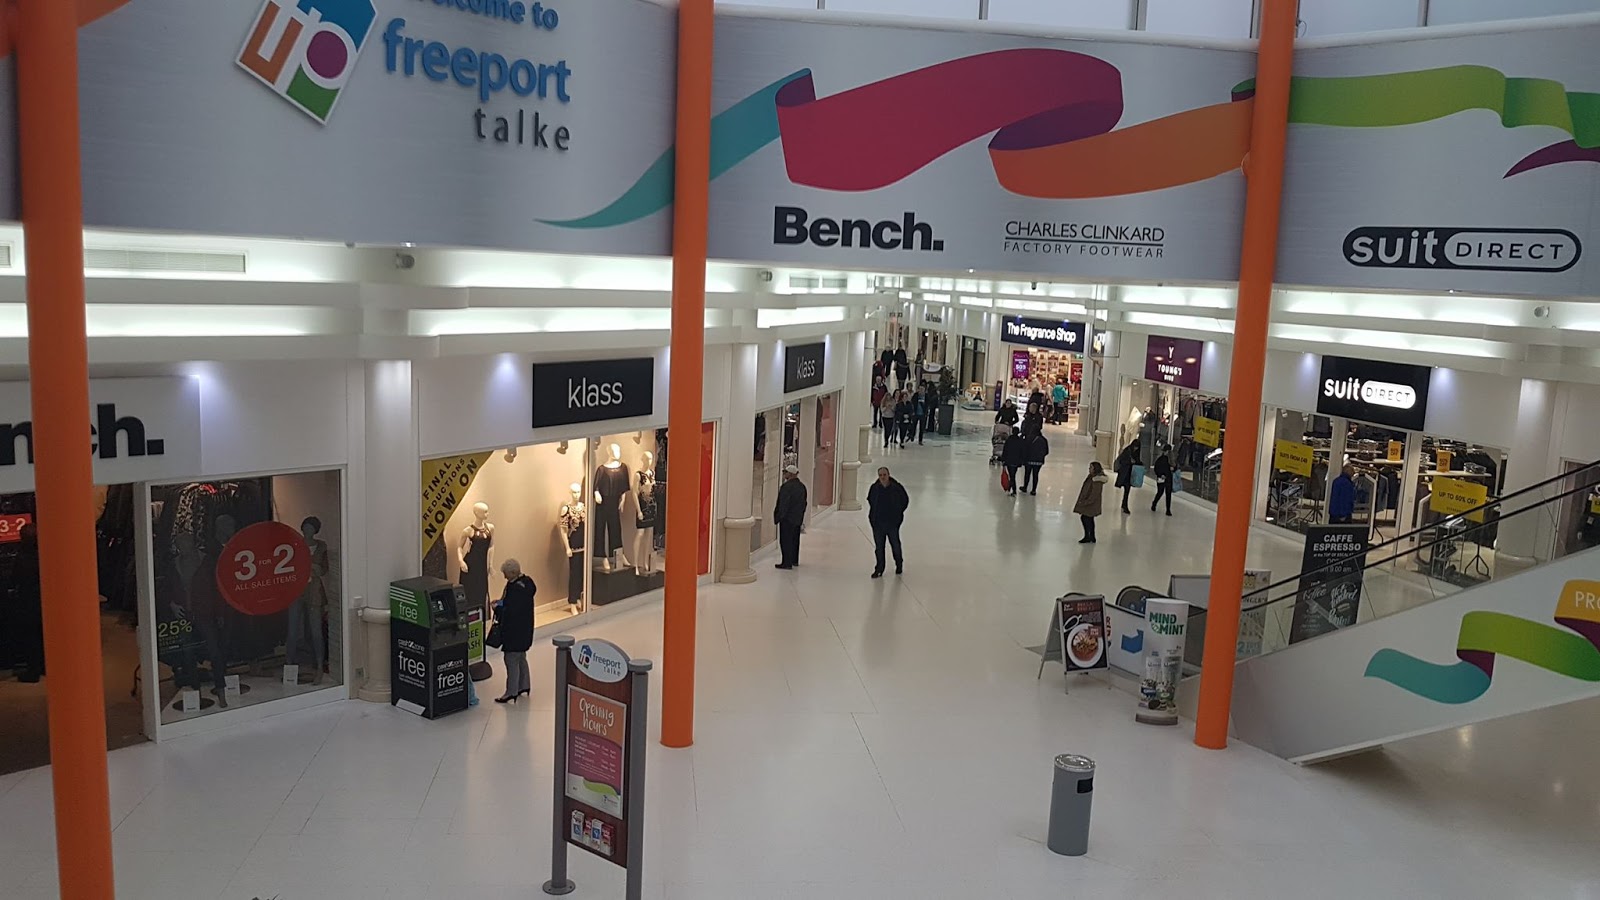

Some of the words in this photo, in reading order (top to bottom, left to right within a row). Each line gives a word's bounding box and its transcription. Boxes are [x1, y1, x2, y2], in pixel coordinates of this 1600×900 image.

[532, 2, 558, 31] to
[383, 17, 571, 102] freeport
[474, 108, 570, 151] talke
[773, 206, 944, 252] Bench.
[1005, 221, 1077, 238] CHARLES
[1081, 225, 1165, 242] CLINKARD
[1004, 241, 1072, 254] FACTORY
[1080, 245, 1163, 258] FOOTWEAR
[1350, 230, 1438, 265] suit
[1456, 242, 1563, 259] DIRECT
[1007, 322, 1019, 336] The
[1020, 324, 1055, 340] Fragrance
[1056, 327, 1076, 345] Shop
[797, 356, 815, 379] klass
[568, 377, 623, 409] klass
[1324, 377, 1360, 401] suit
[1366, 387, 1410, 403] DIRECT
[0, 404, 164, 465] nh.
[423, 462, 451, 500] FINAL
[423, 458, 465, 520] REDUCTIONS
[424, 492, 456, 539] NOW
[459, 458, 478, 487] ON
[1313, 543, 1361, 551] ESPRESSO
[1324, 534, 1353, 543] CAFFE
[234, 550, 257, 580] 3
[273, 544, 295, 575] 2
[235, 583, 249, 591] ALL
[251, 579, 271, 589] SALE
[273, 575, 297, 585] ITEMS
[399, 601, 418, 619] free
[1149, 612, 1177, 624] MIND
[158, 619, 193, 638] 25%
[1160, 624, 1185, 635] MINT
[398, 651, 426, 677] free
[593, 652, 621, 669] freeport
[603, 666, 621, 677] talke
[437, 671, 464, 689] free
[579, 698, 614, 727] Opening
[583, 712, 607, 736] hours
